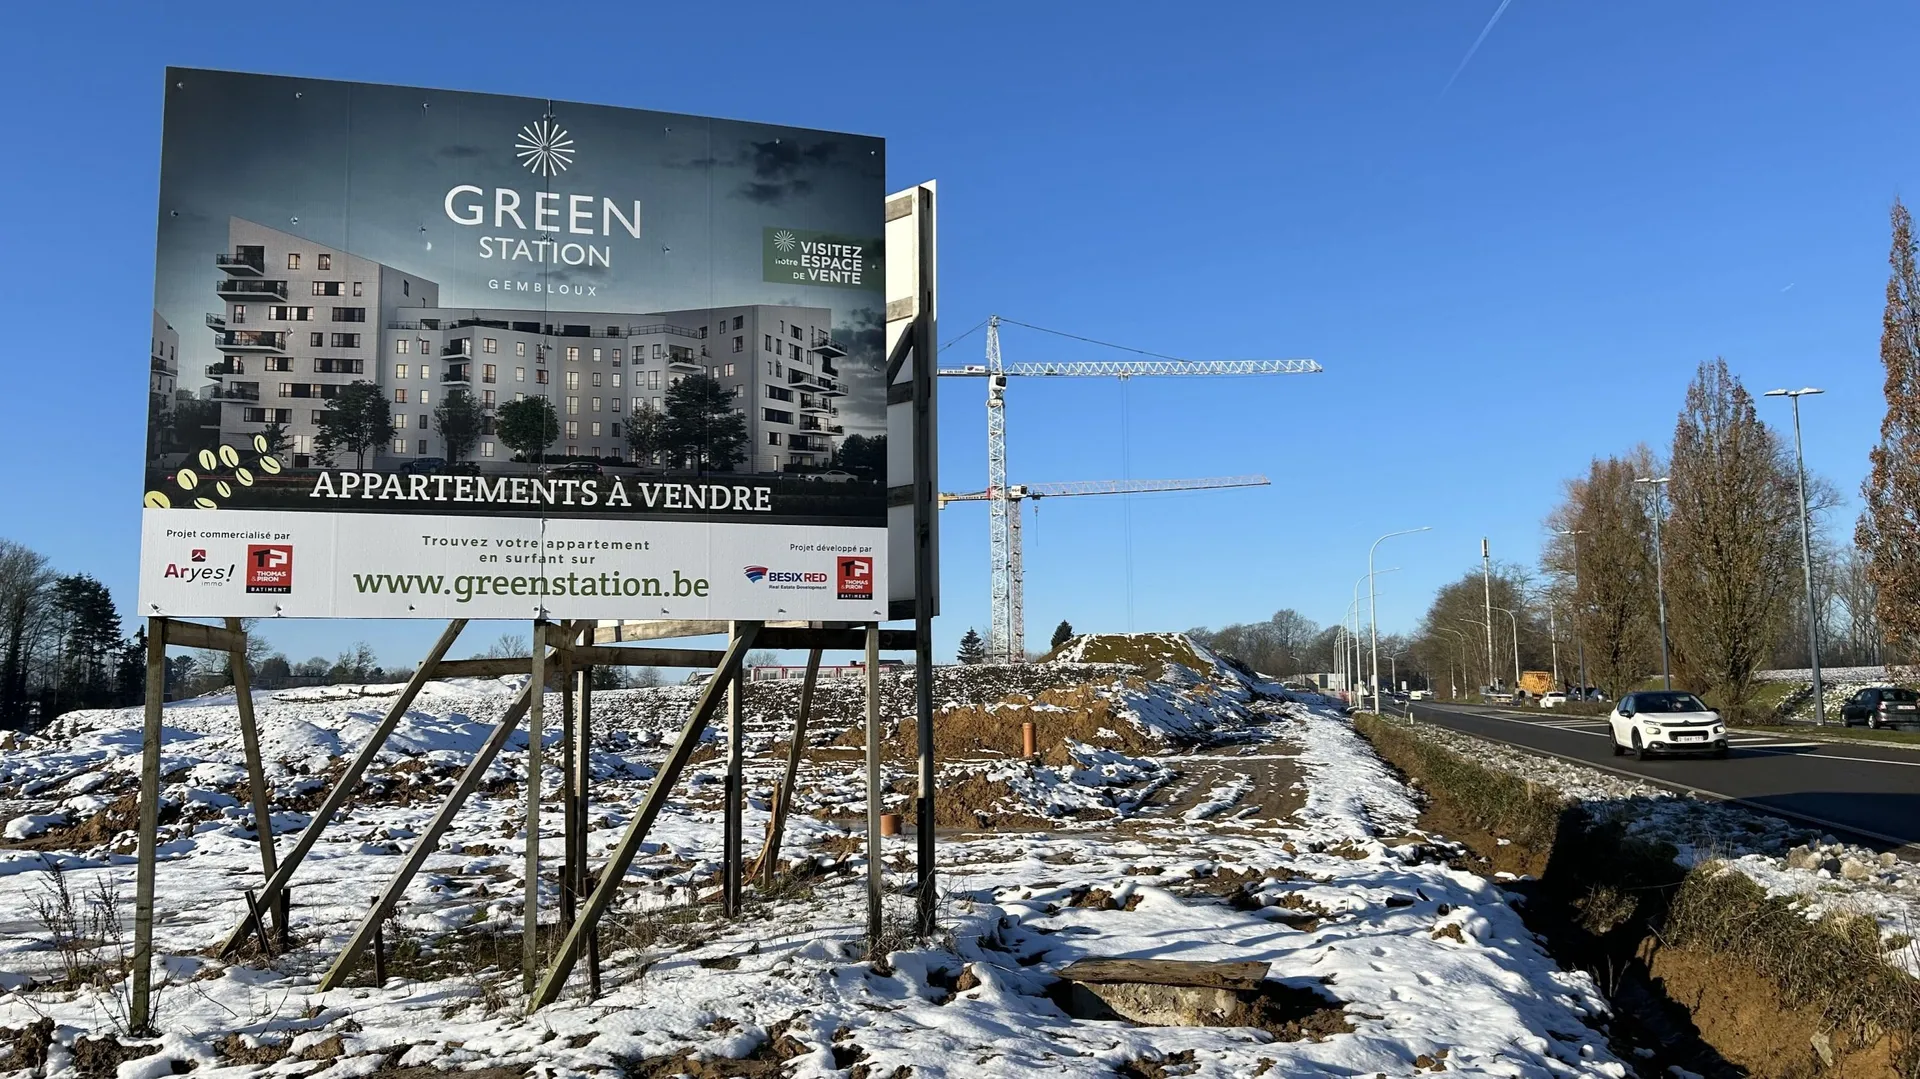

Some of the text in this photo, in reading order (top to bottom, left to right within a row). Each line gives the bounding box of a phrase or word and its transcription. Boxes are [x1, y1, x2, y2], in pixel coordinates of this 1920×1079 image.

[444, 184, 641, 239] GREEN
[479, 236, 610, 268] STATION
[800, 241, 863, 259] VISITEZ
[801, 254, 862, 272] ESPACE
[793, 268, 862, 285] DE VENTE
[488, 279, 597, 297] GEMBLOUX
[309, 471, 772, 512] APPARTEMENTS À VENDRE
[166, 529, 291, 541] Projet commercialisé par
[422, 535, 650, 551] Trouvez votre appartement
[790, 543, 872, 553] Projet développé par
[479, 552, 596, 565] en surfant sur
[164, 563, 236, 583] Aryes!
[353, 570, 710, 603] www.greenstation.be
